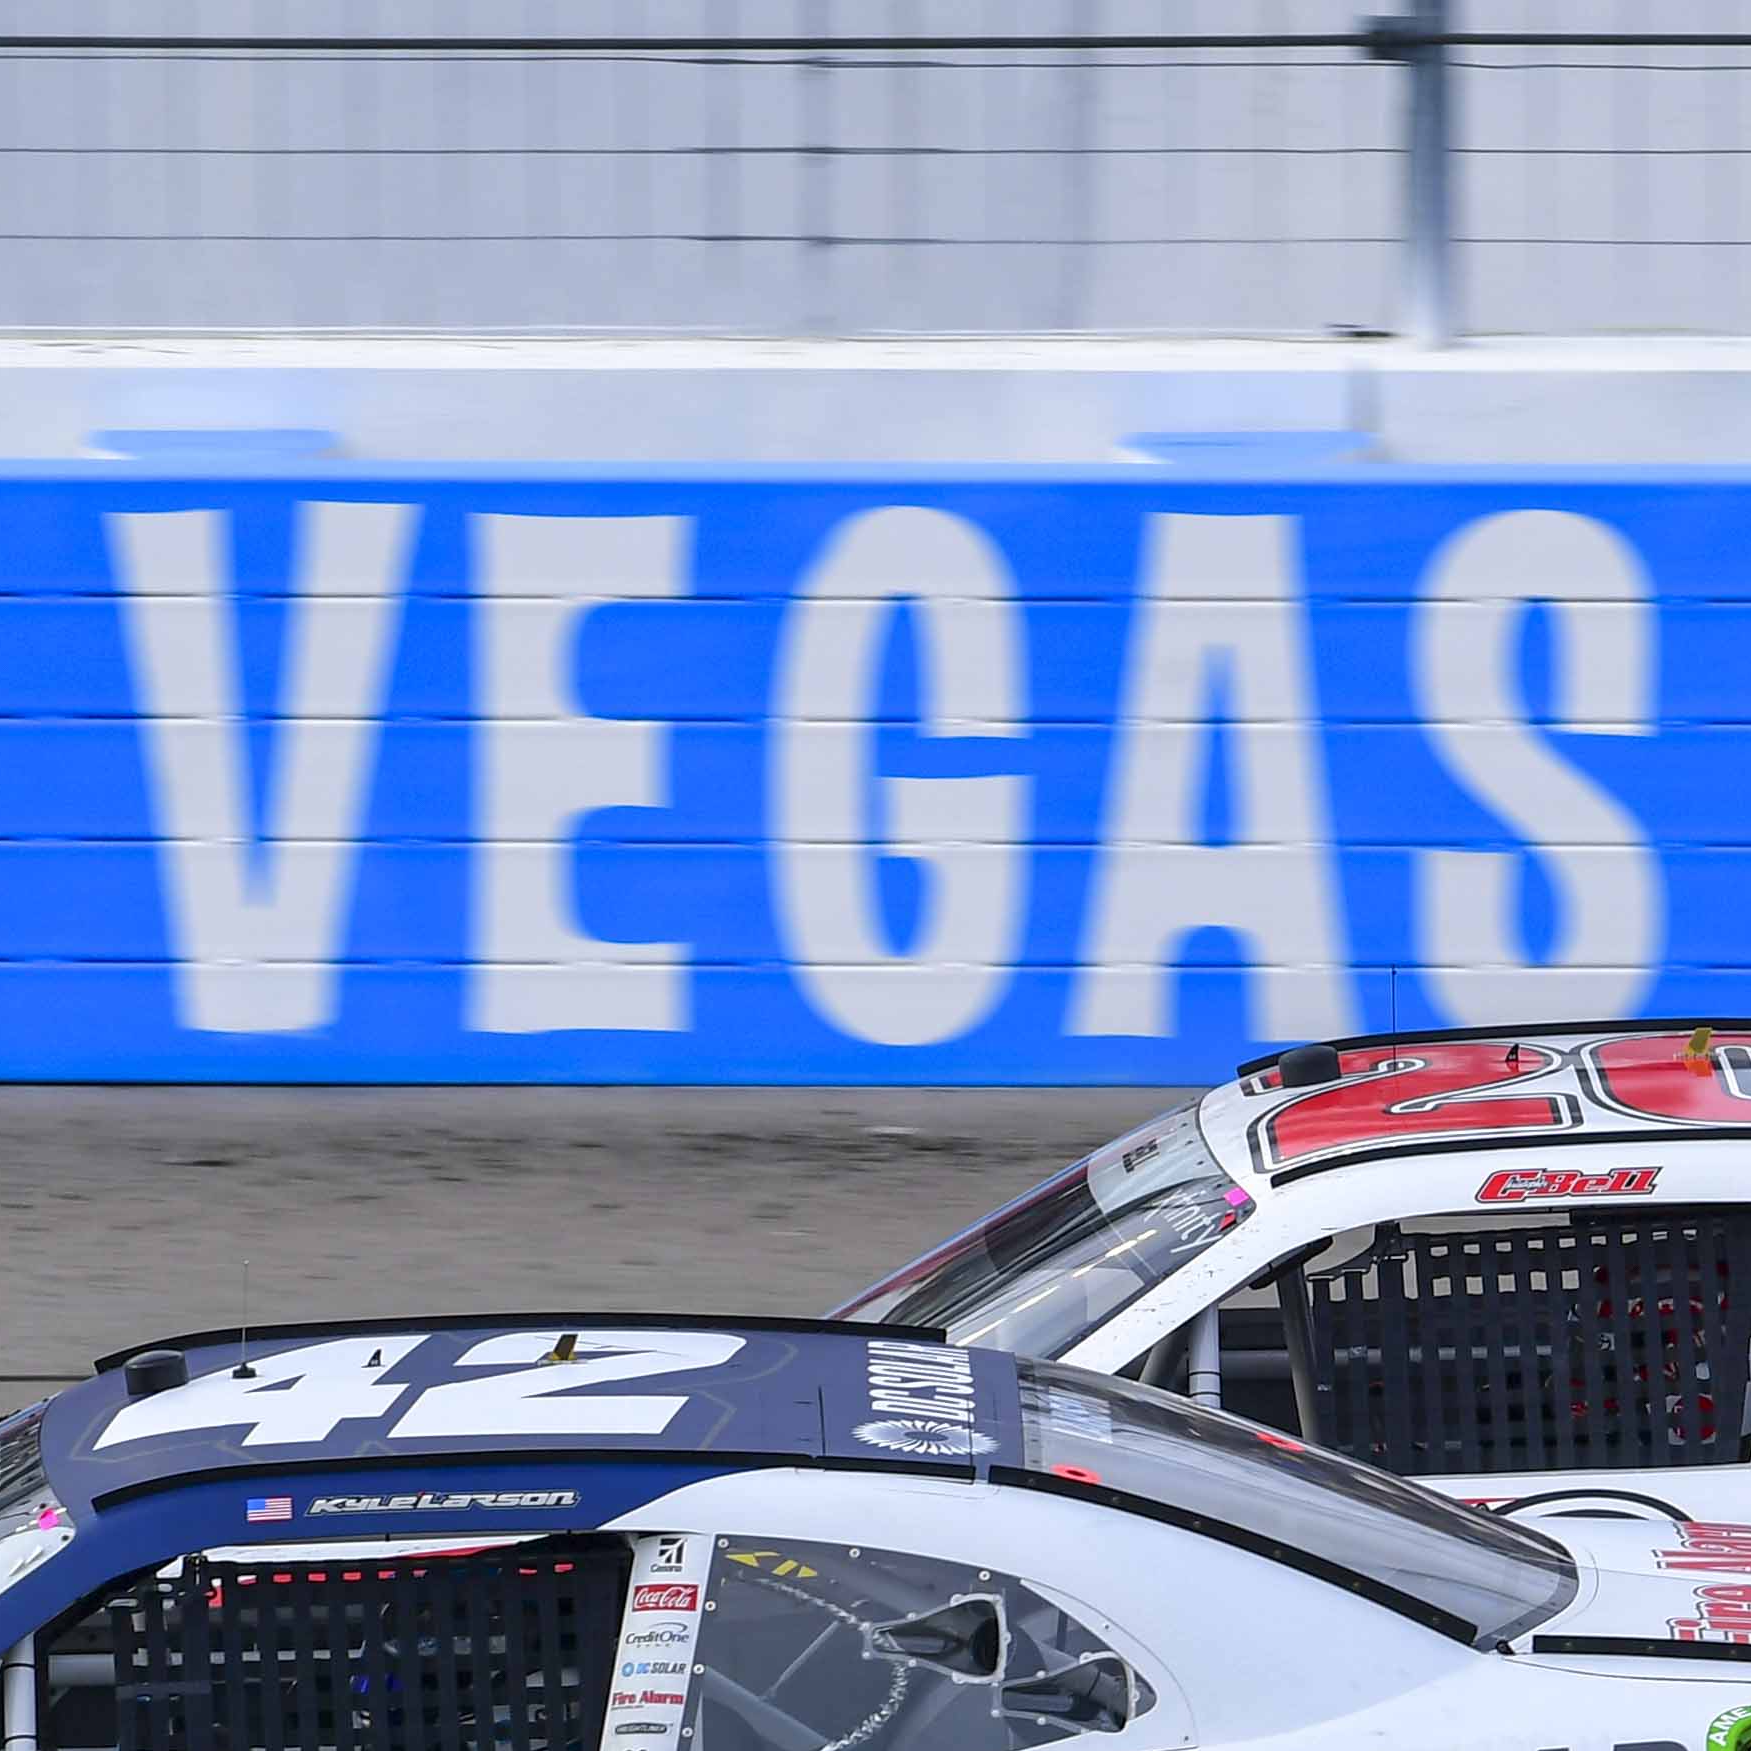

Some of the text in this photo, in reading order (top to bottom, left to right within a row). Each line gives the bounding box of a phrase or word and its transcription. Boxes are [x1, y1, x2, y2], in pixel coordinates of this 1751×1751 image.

[102, 500, 1667, 1048] VEGAS
[91, 1329, 748, 1451] 42
[867, 1340, 975, 1394] SOLAR
[651, 1661, 687, 1674] SOLAR
[611, 1689, 684, 1706] Fire Alarm
